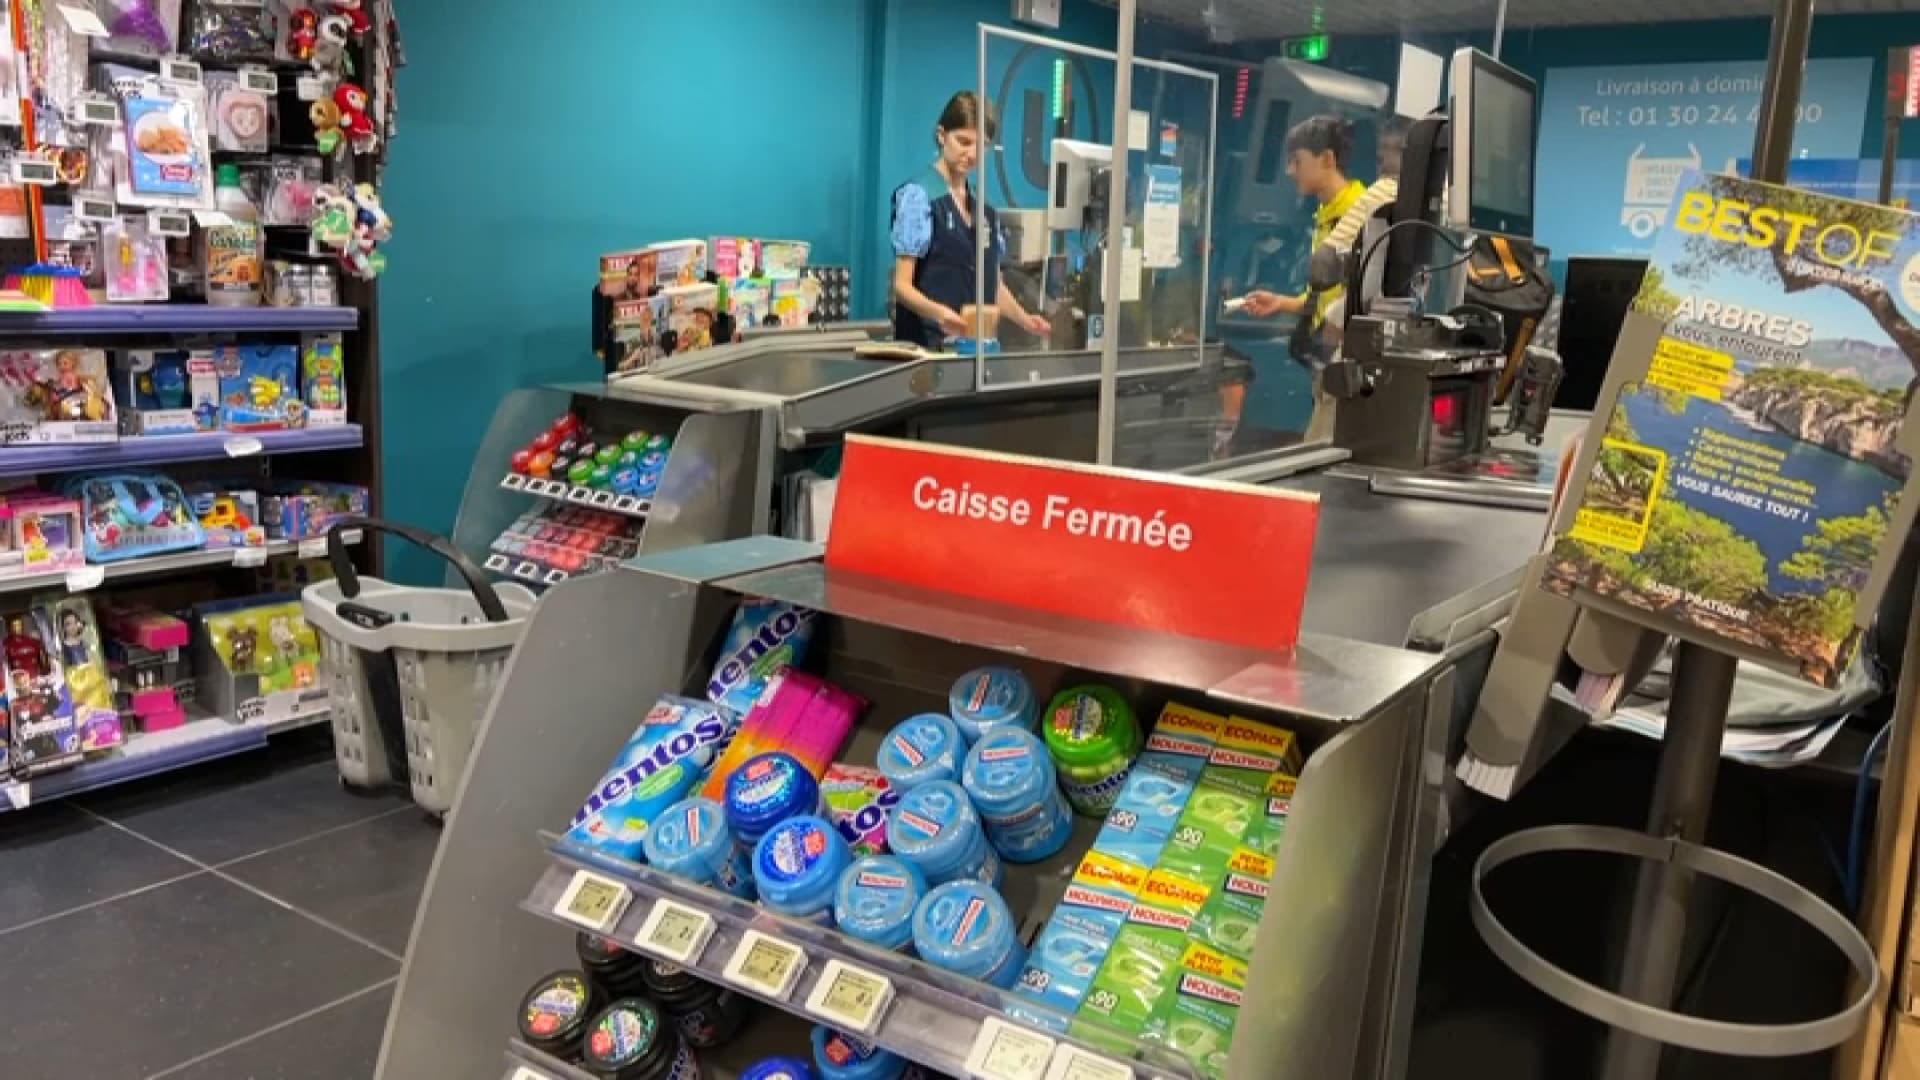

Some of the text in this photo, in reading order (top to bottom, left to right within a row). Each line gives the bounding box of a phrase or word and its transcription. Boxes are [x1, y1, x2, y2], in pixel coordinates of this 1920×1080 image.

[1596, 76, 1684, 97] Livraison
[1688, 76, 1700, 94] à
[1577, 104, 1609, 127] Tel
[1628, 105, 1657, 127] 01
[1666, 104, 1699, 127] 30
[1706, 103, 1737, 125] 24
[1674, 191, 1902, 270] BEST OF
[1673, 294, 1814, 348] ARBRES
[1718, 333, 1804, 365] entourent
[1676, 473, 1711, 495] VOUS
[1711, 485, 1764, 511] SAUREZ
[1765, 500, 1801, 521] TOUT
[912, 476, 1194, 552] Caisse Fermée
[1223, 723, 1287, 748] ECOPACK
[1214, 750, 1278, 770] HOLLYWOOD
[1231, 876, 1267, 894] HOLLY
[1068, 888, 1131, 911] HOLLYWOOD
